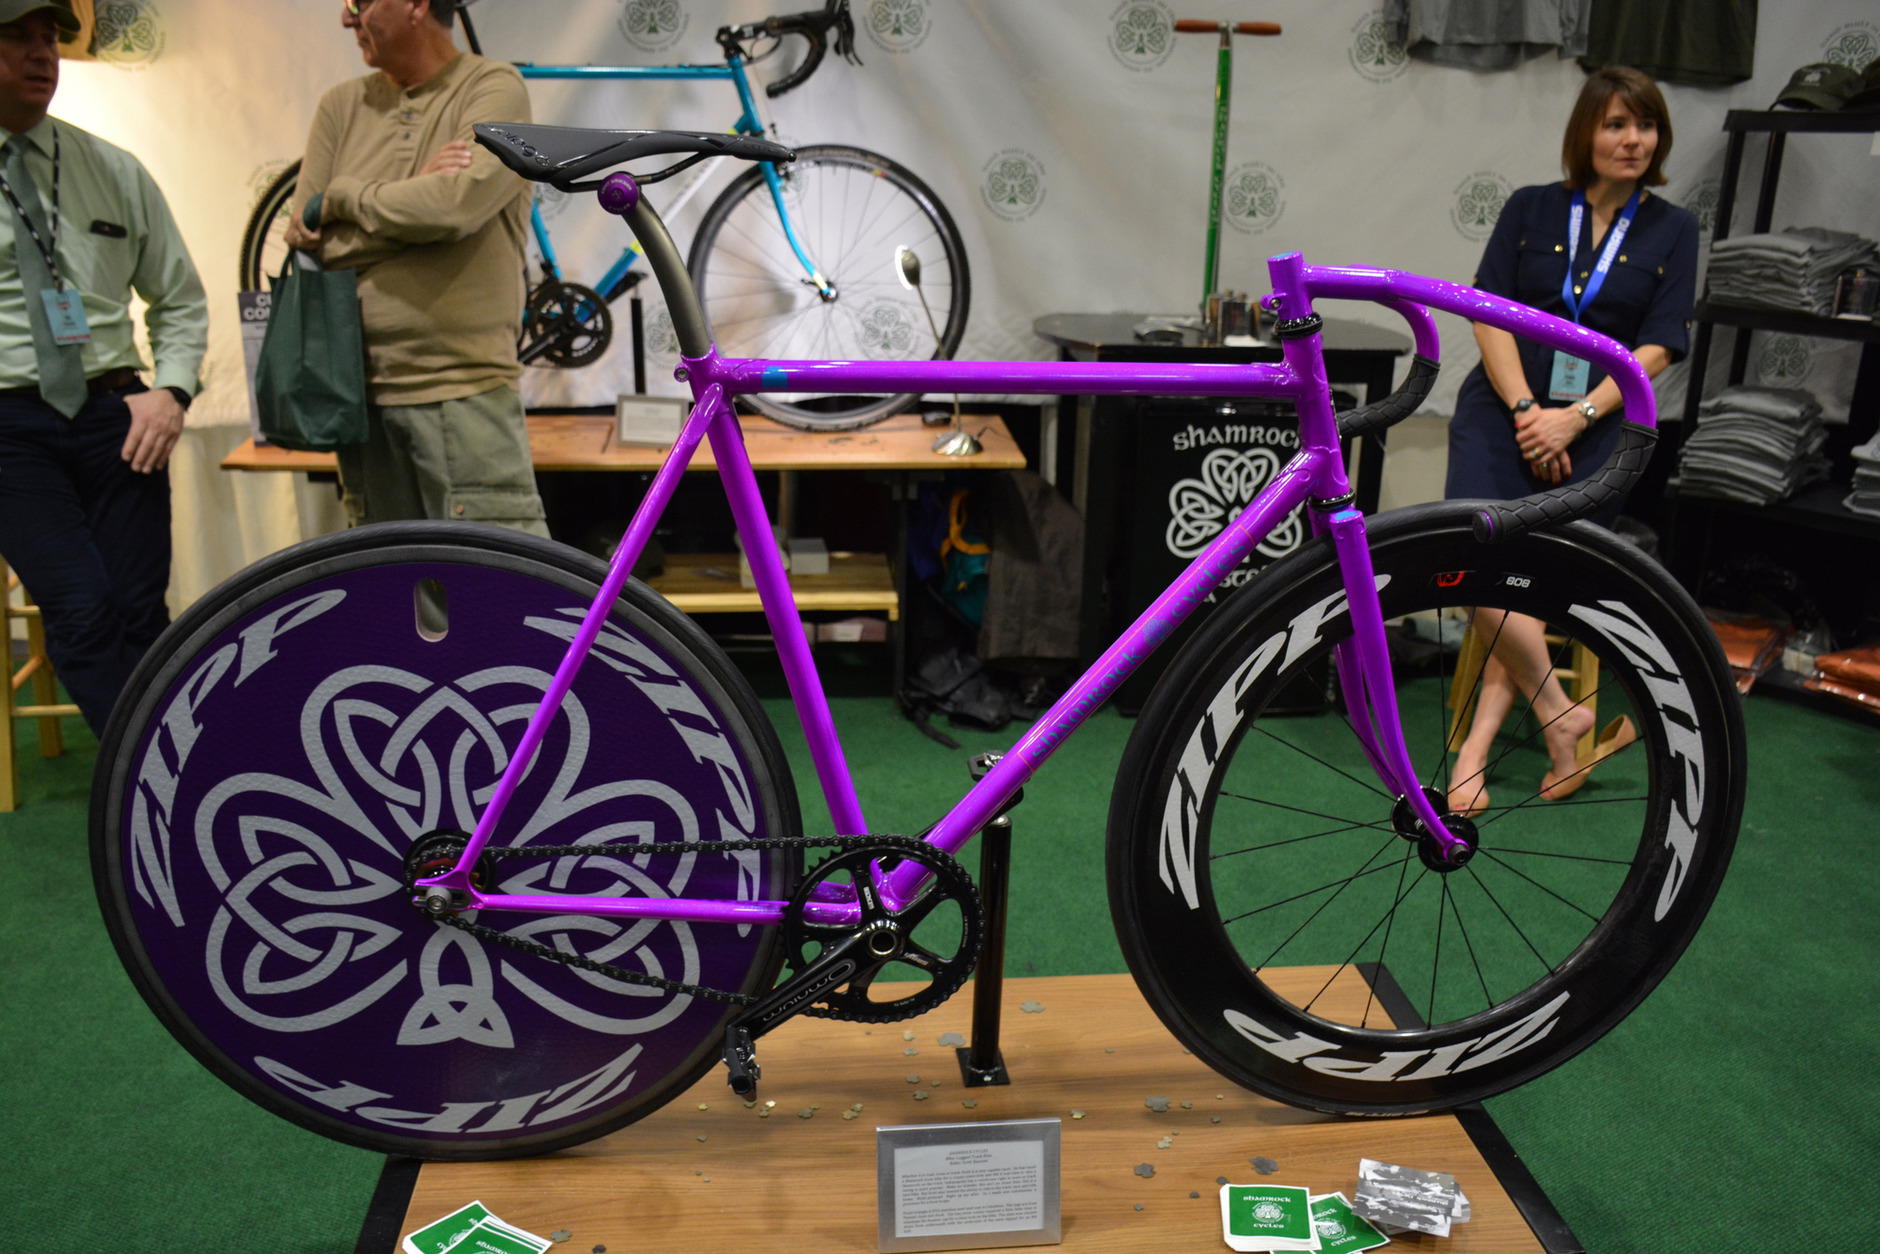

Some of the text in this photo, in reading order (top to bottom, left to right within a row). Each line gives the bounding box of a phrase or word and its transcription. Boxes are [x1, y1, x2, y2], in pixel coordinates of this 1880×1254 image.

[1159, 573, 1392, 910] ZIPP
[1506, 576, 1531, 588] 808
[131, 589, 347, 927] ZIPP
[523, 607, 760, 938] ZIPP
[1568, 600, 1705, 922] ZIPP
[254, 1043, 643, 1133] ZIPP
[1223, 991, 1570, 1082] ZIPP
